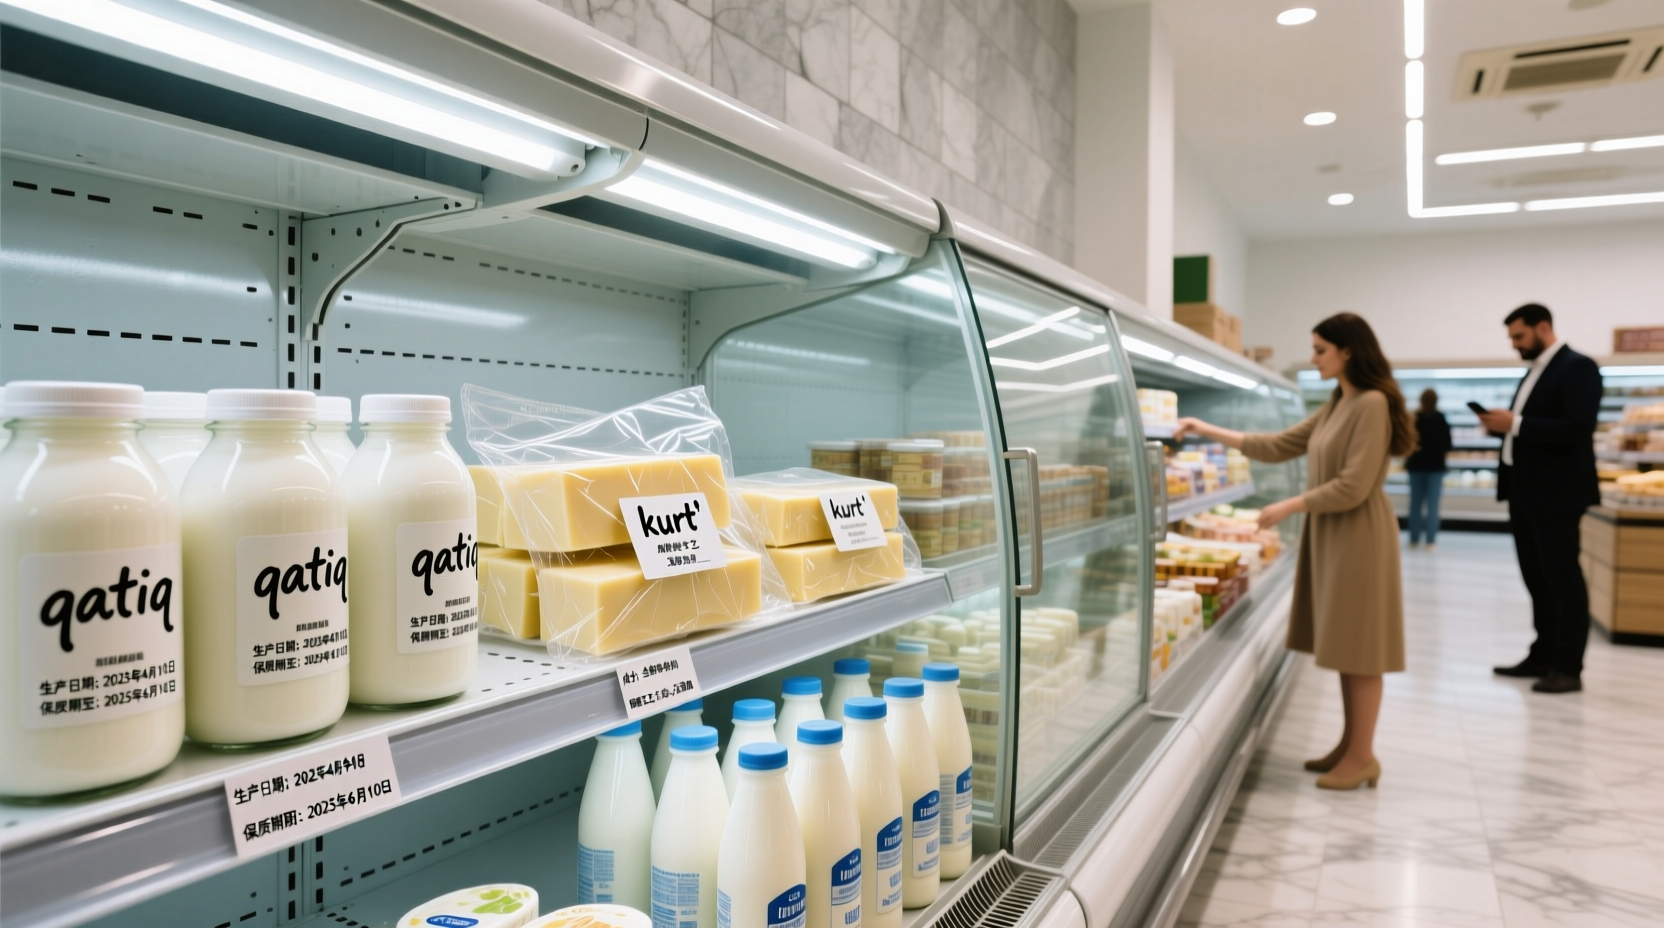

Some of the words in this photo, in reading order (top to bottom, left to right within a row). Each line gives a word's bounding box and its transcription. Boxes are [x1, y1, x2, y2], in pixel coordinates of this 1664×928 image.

[637, 499, 700, 538] kurt'
[829, 495, 867, 520] kurt'
[40, 566, 175, 653] qatiq
[254, 546, 348, 620] qatiq
